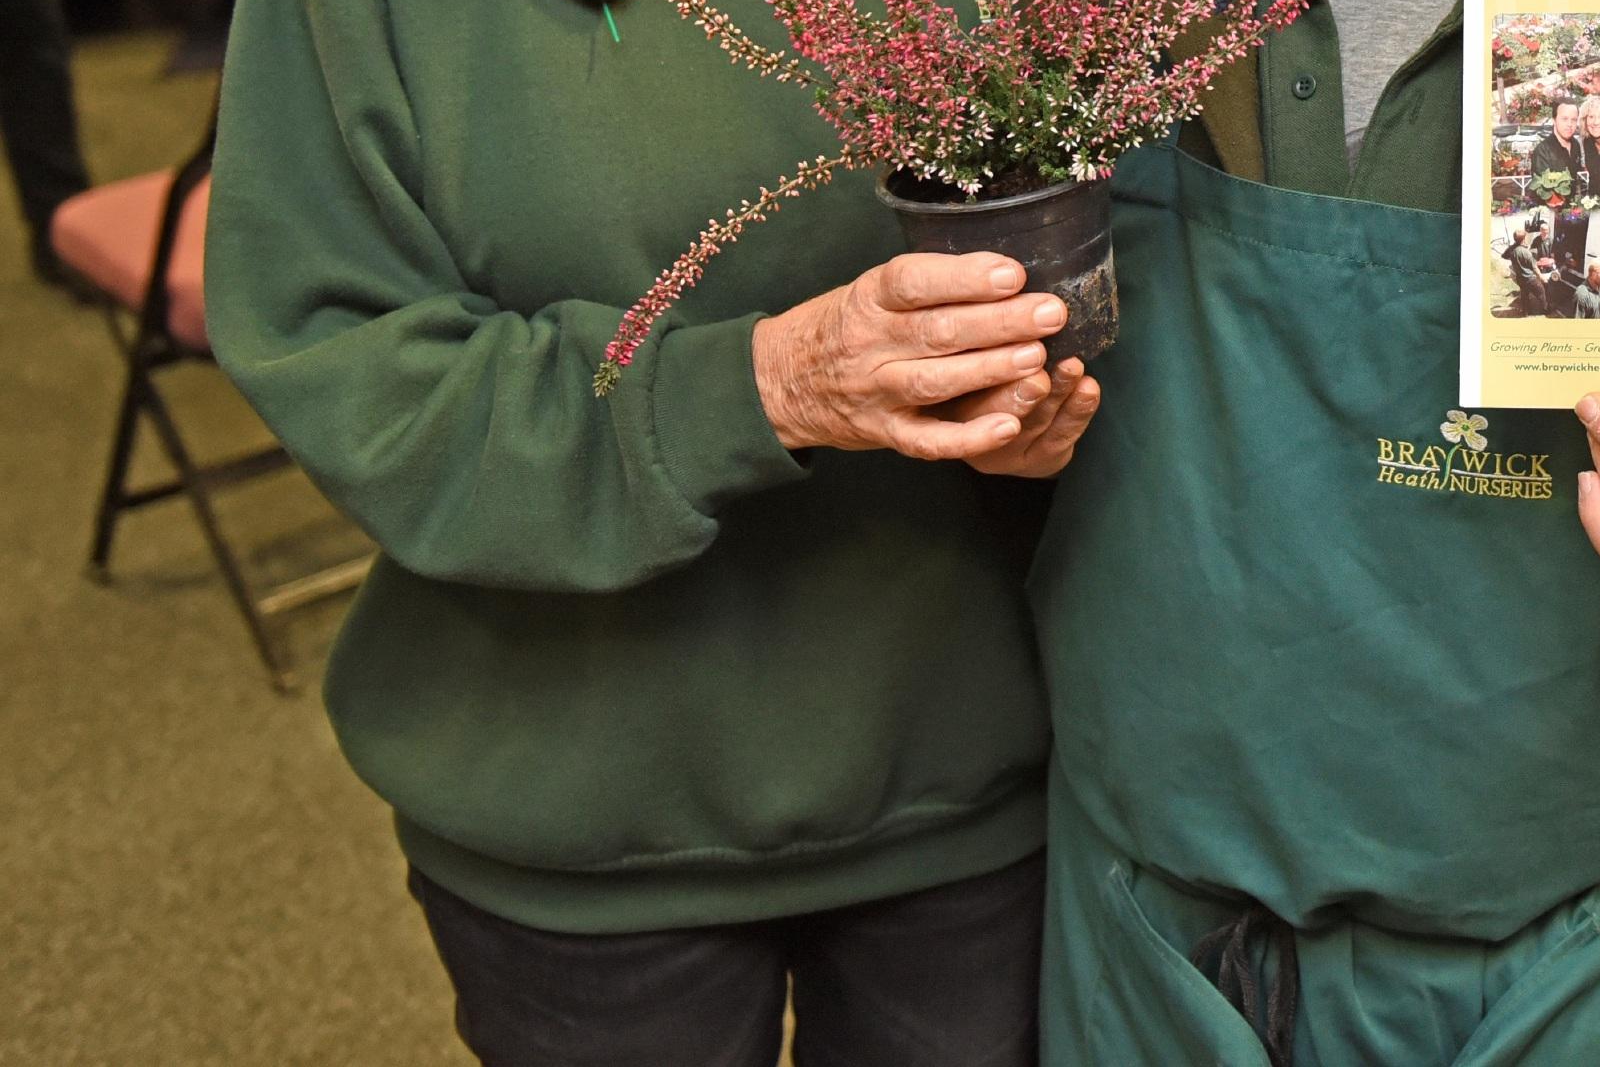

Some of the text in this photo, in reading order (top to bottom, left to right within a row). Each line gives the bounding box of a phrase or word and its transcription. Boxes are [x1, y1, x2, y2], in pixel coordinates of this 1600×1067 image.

[1490, 342, 1538, 354] Growing
[1540, 342, 1573, 353] Plants
[1377, 438, 1553, 479] BRAYWICK
[1377, 465, 1553, 499] Heath NURSERIES
